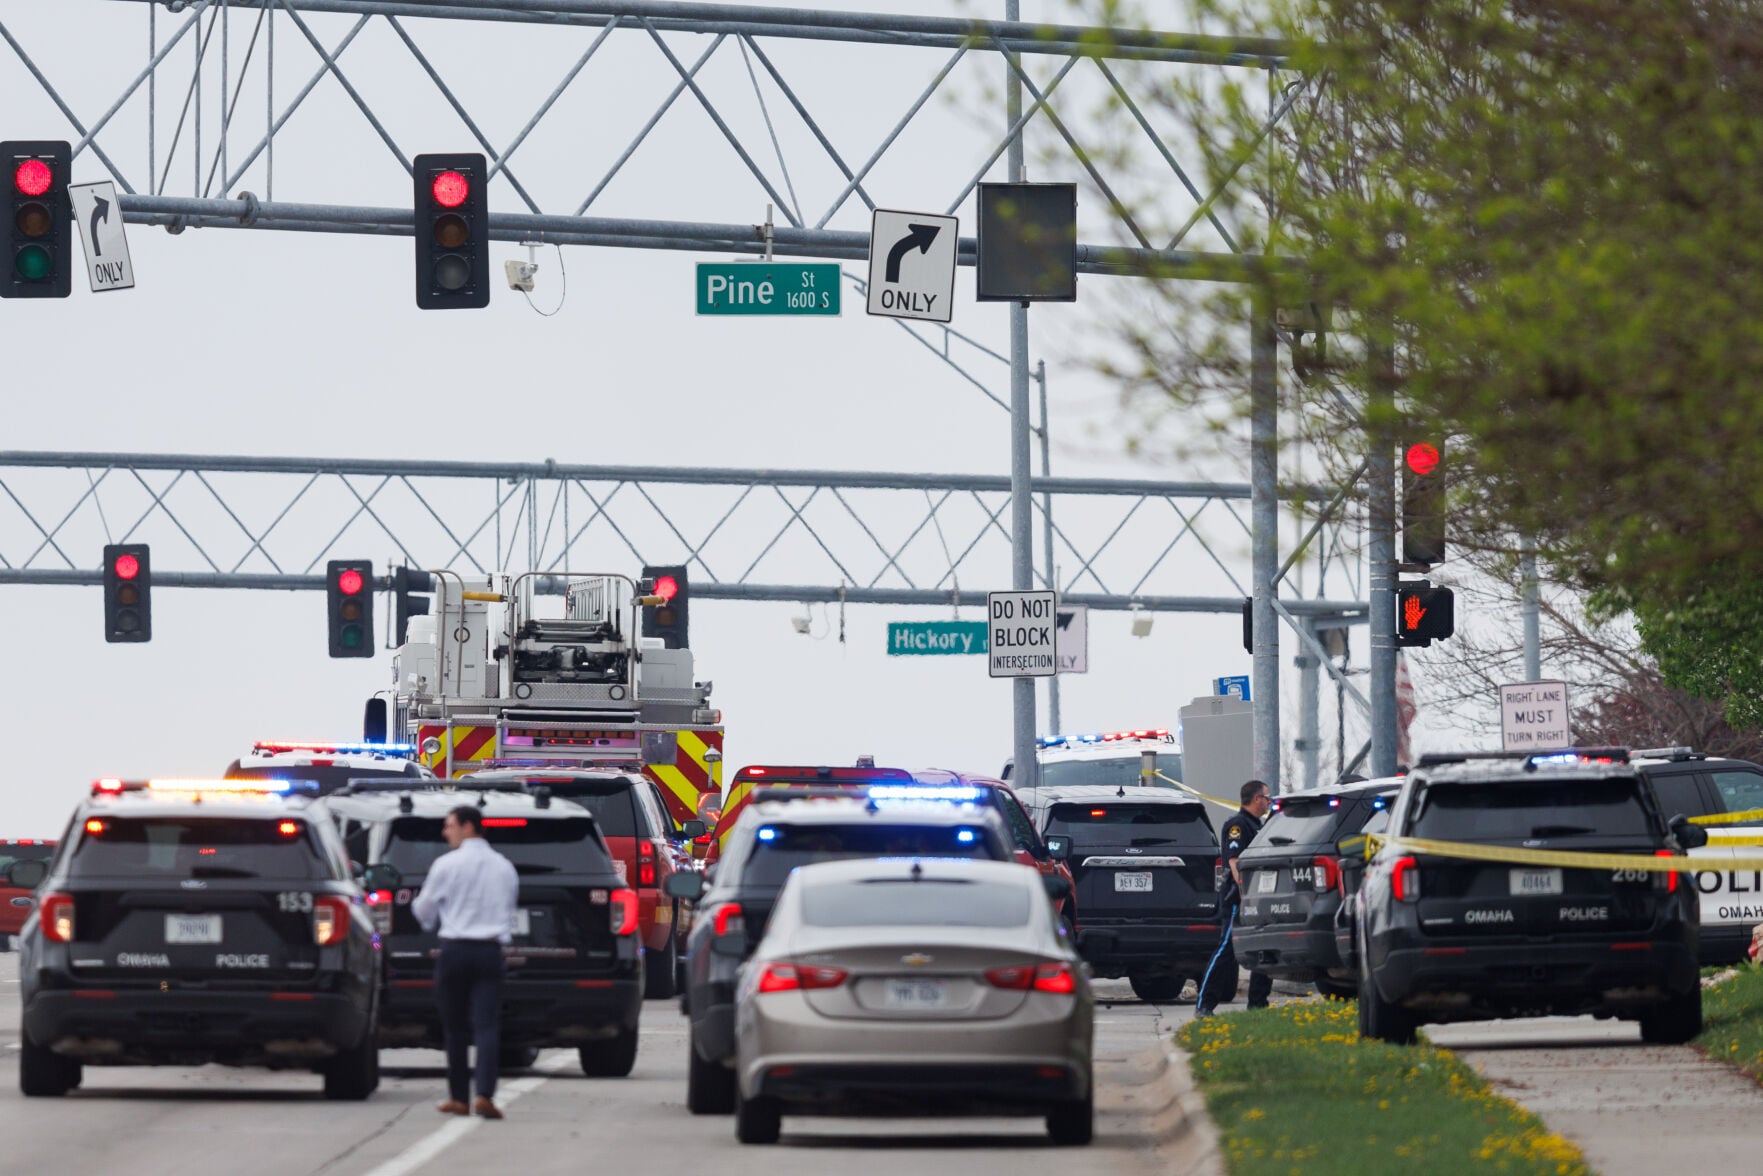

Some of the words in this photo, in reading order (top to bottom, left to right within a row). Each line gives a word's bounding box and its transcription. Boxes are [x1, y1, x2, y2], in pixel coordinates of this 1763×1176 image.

[96, 261, 123, 284] ONLY
[801, 271, 815, 288] St
[707, 274, 775, 305] Pine
[786, 291, 816, 308] 1600
[821, 291, 830, 308] S
[881, 289, 938, 313] ONLY
[993, 600, 1014, 619] DO
[1021, 599, 1052, 618] NOT
[894, 628, 975, 653] Hickory
[995, 627, 1050, 647] BLOCK
[993, 654, 1053, 669] INTERSECTION
[1506, 692, 1533, 703] RIGHT
[1536, 690, 1561, 702] LANE
[1515, 709, 1553, 724] MUST
[1507, 732, 1532, 743] TURN
[1536, 729, 1564, 741] RIGHT
[1293, 867, 1312, 882] 444
[278, 892, 313, 913] 153
[1270, 904, 1290, 914] POLICE
[1464, 909, 1514, 924] OMAHA
[1559, 907, 1609, 920] POLICE
[1718, 906, 1763, 919] OMAH
[117, 952, 171, 967] OMAHA
[215, 954, 270, 969] POLICE
